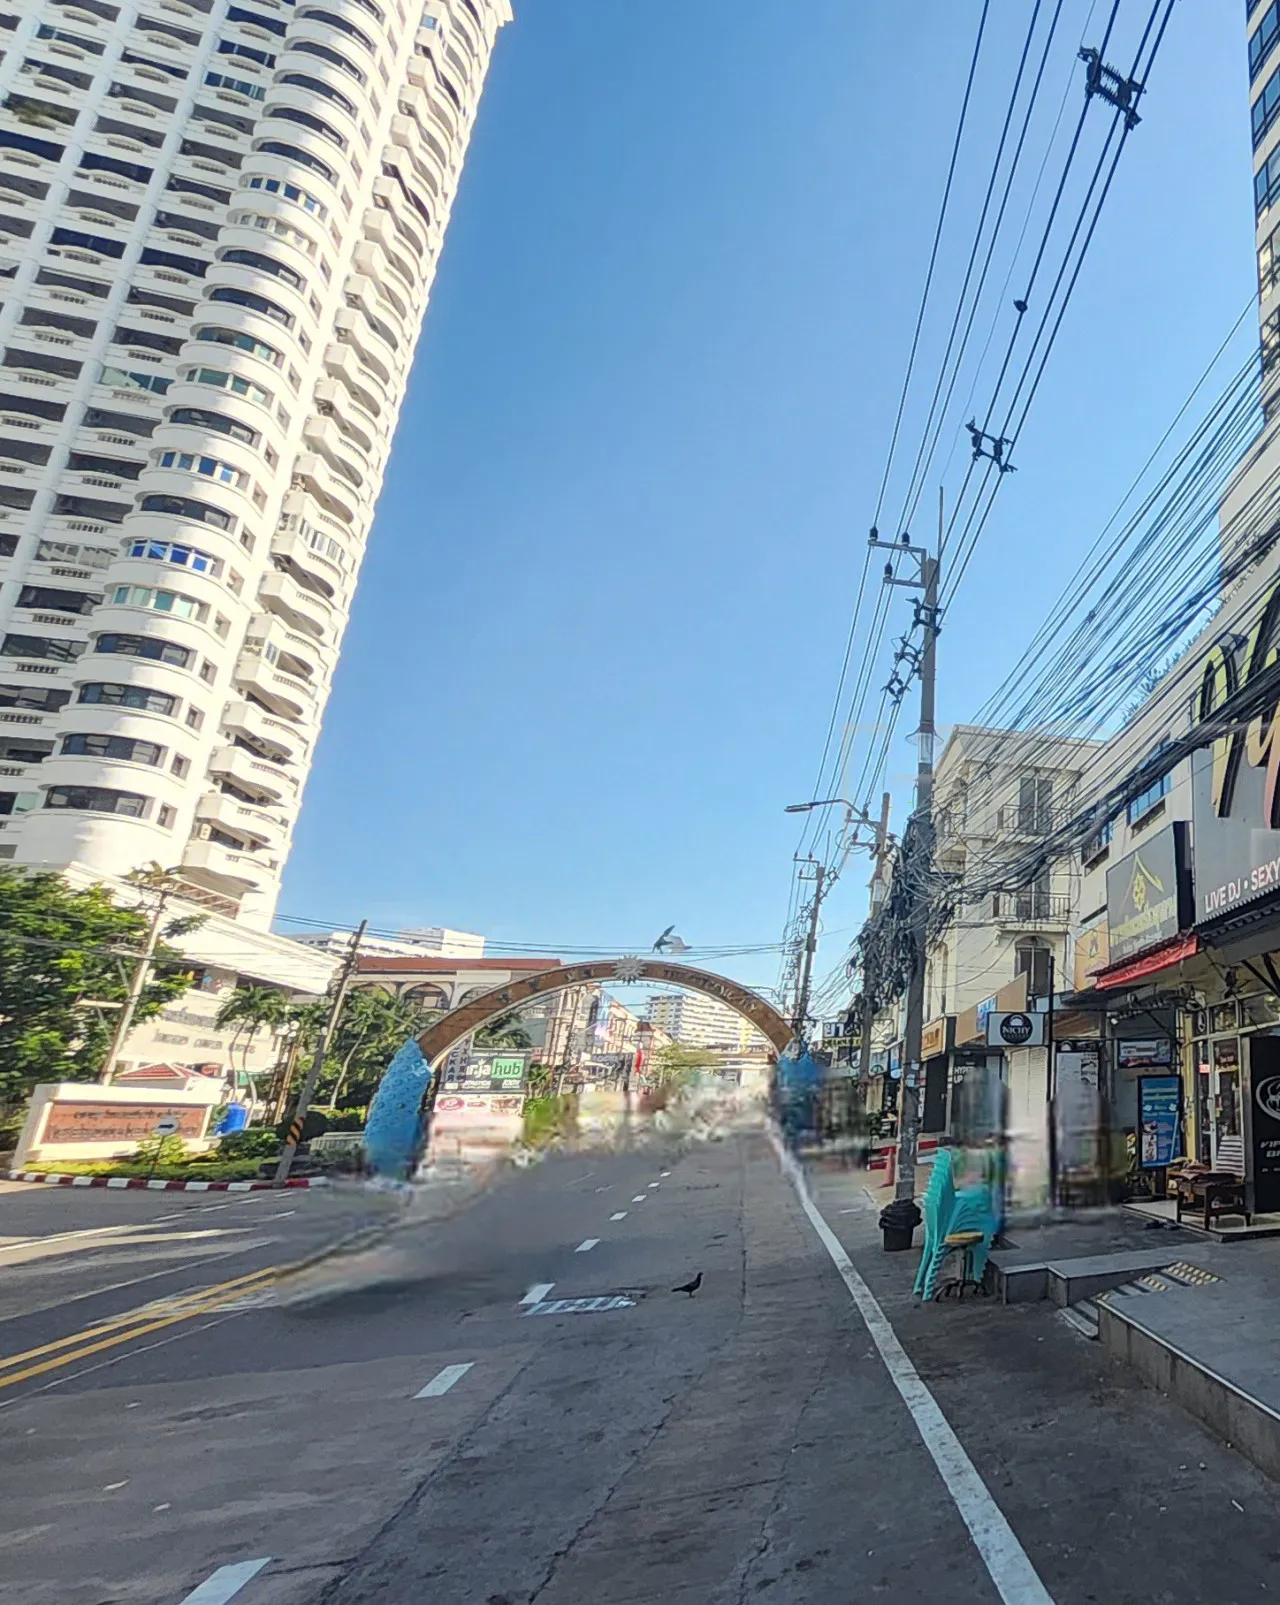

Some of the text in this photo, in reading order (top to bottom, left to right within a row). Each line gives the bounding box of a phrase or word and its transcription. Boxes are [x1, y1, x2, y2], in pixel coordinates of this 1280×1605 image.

[1204, 885, 1227, 914] LIVE
[1228, 878, 1242, 903] DJ
[1251, 857, 1280, 891] SEXY
[493, 1061, 521, 1076] hub
